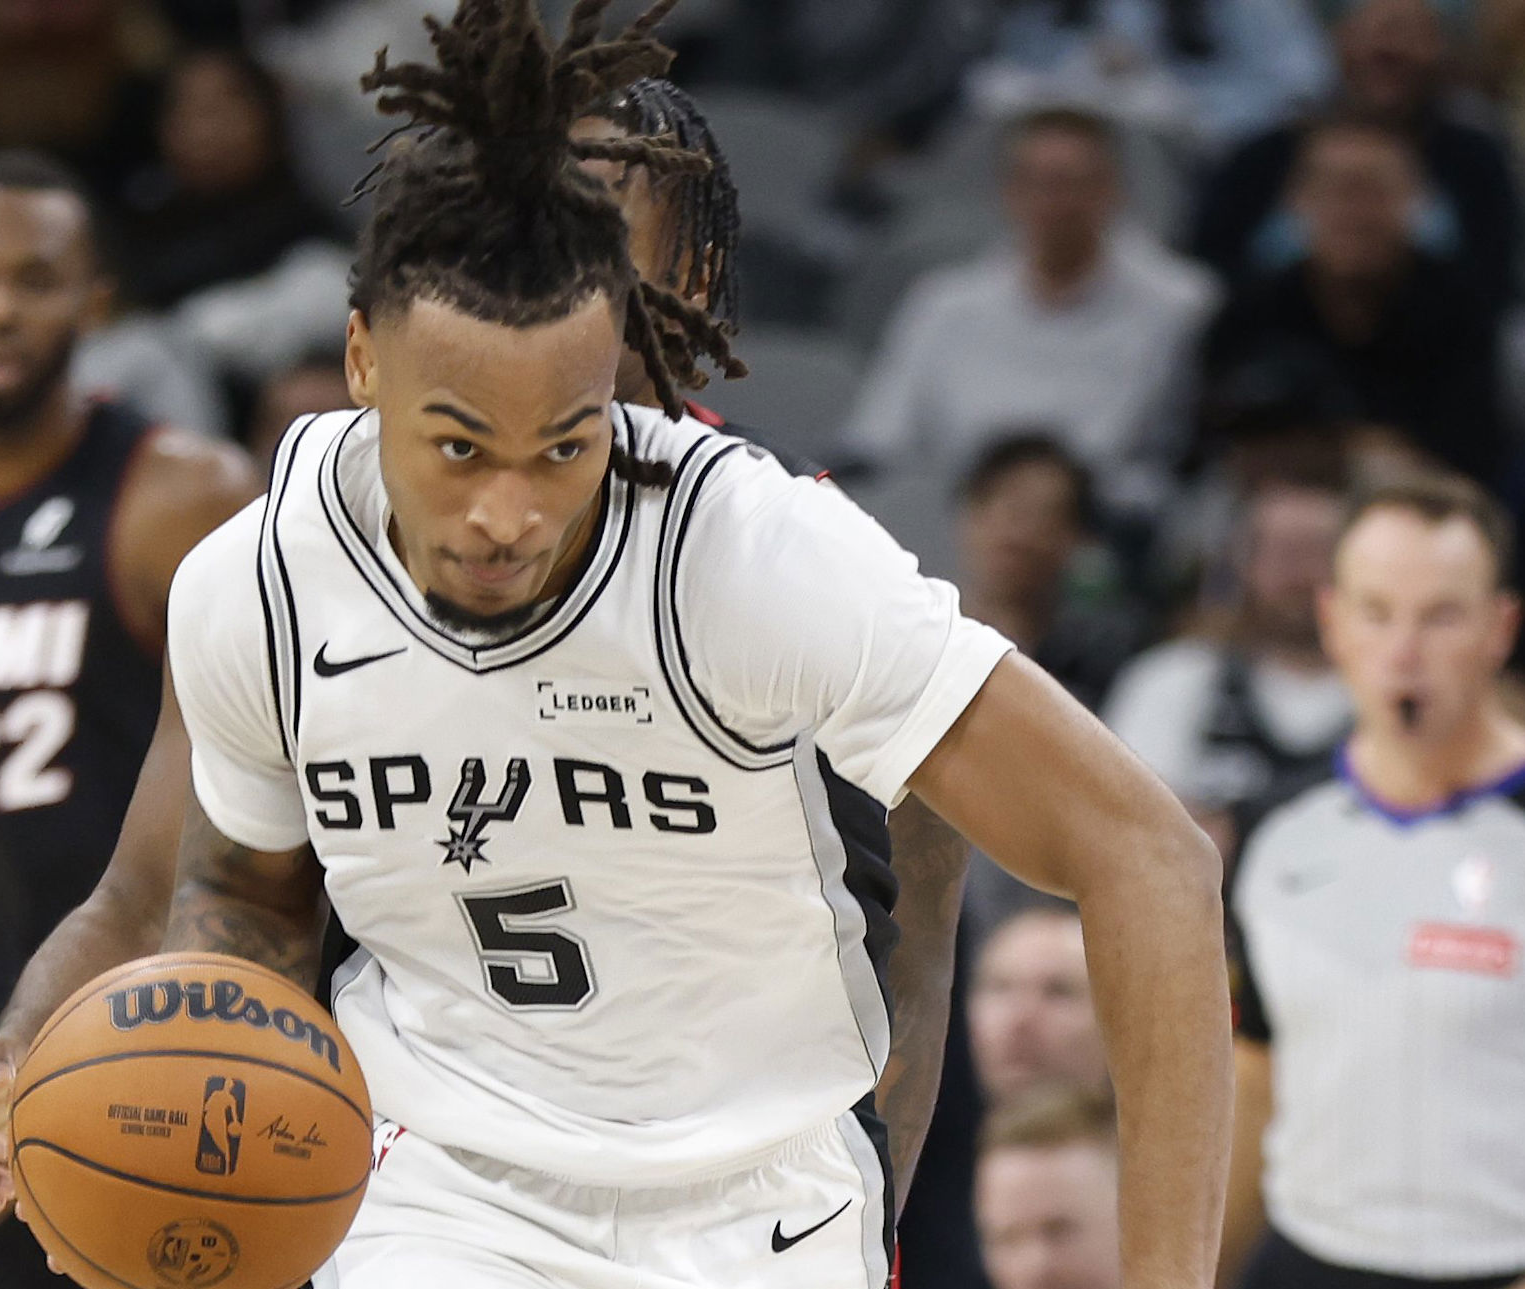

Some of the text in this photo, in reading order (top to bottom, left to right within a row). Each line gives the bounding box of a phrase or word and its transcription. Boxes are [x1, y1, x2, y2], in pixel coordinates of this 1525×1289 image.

[553, 693, 637, 713] LEDGER
[305, 757, 717, 873] SPURS
[452, 876, 600, 1013] 5
[105, 979, 341, 1074] Wilson
[107, 1104, 189, 1126] OFFICIAL GAME BALL
